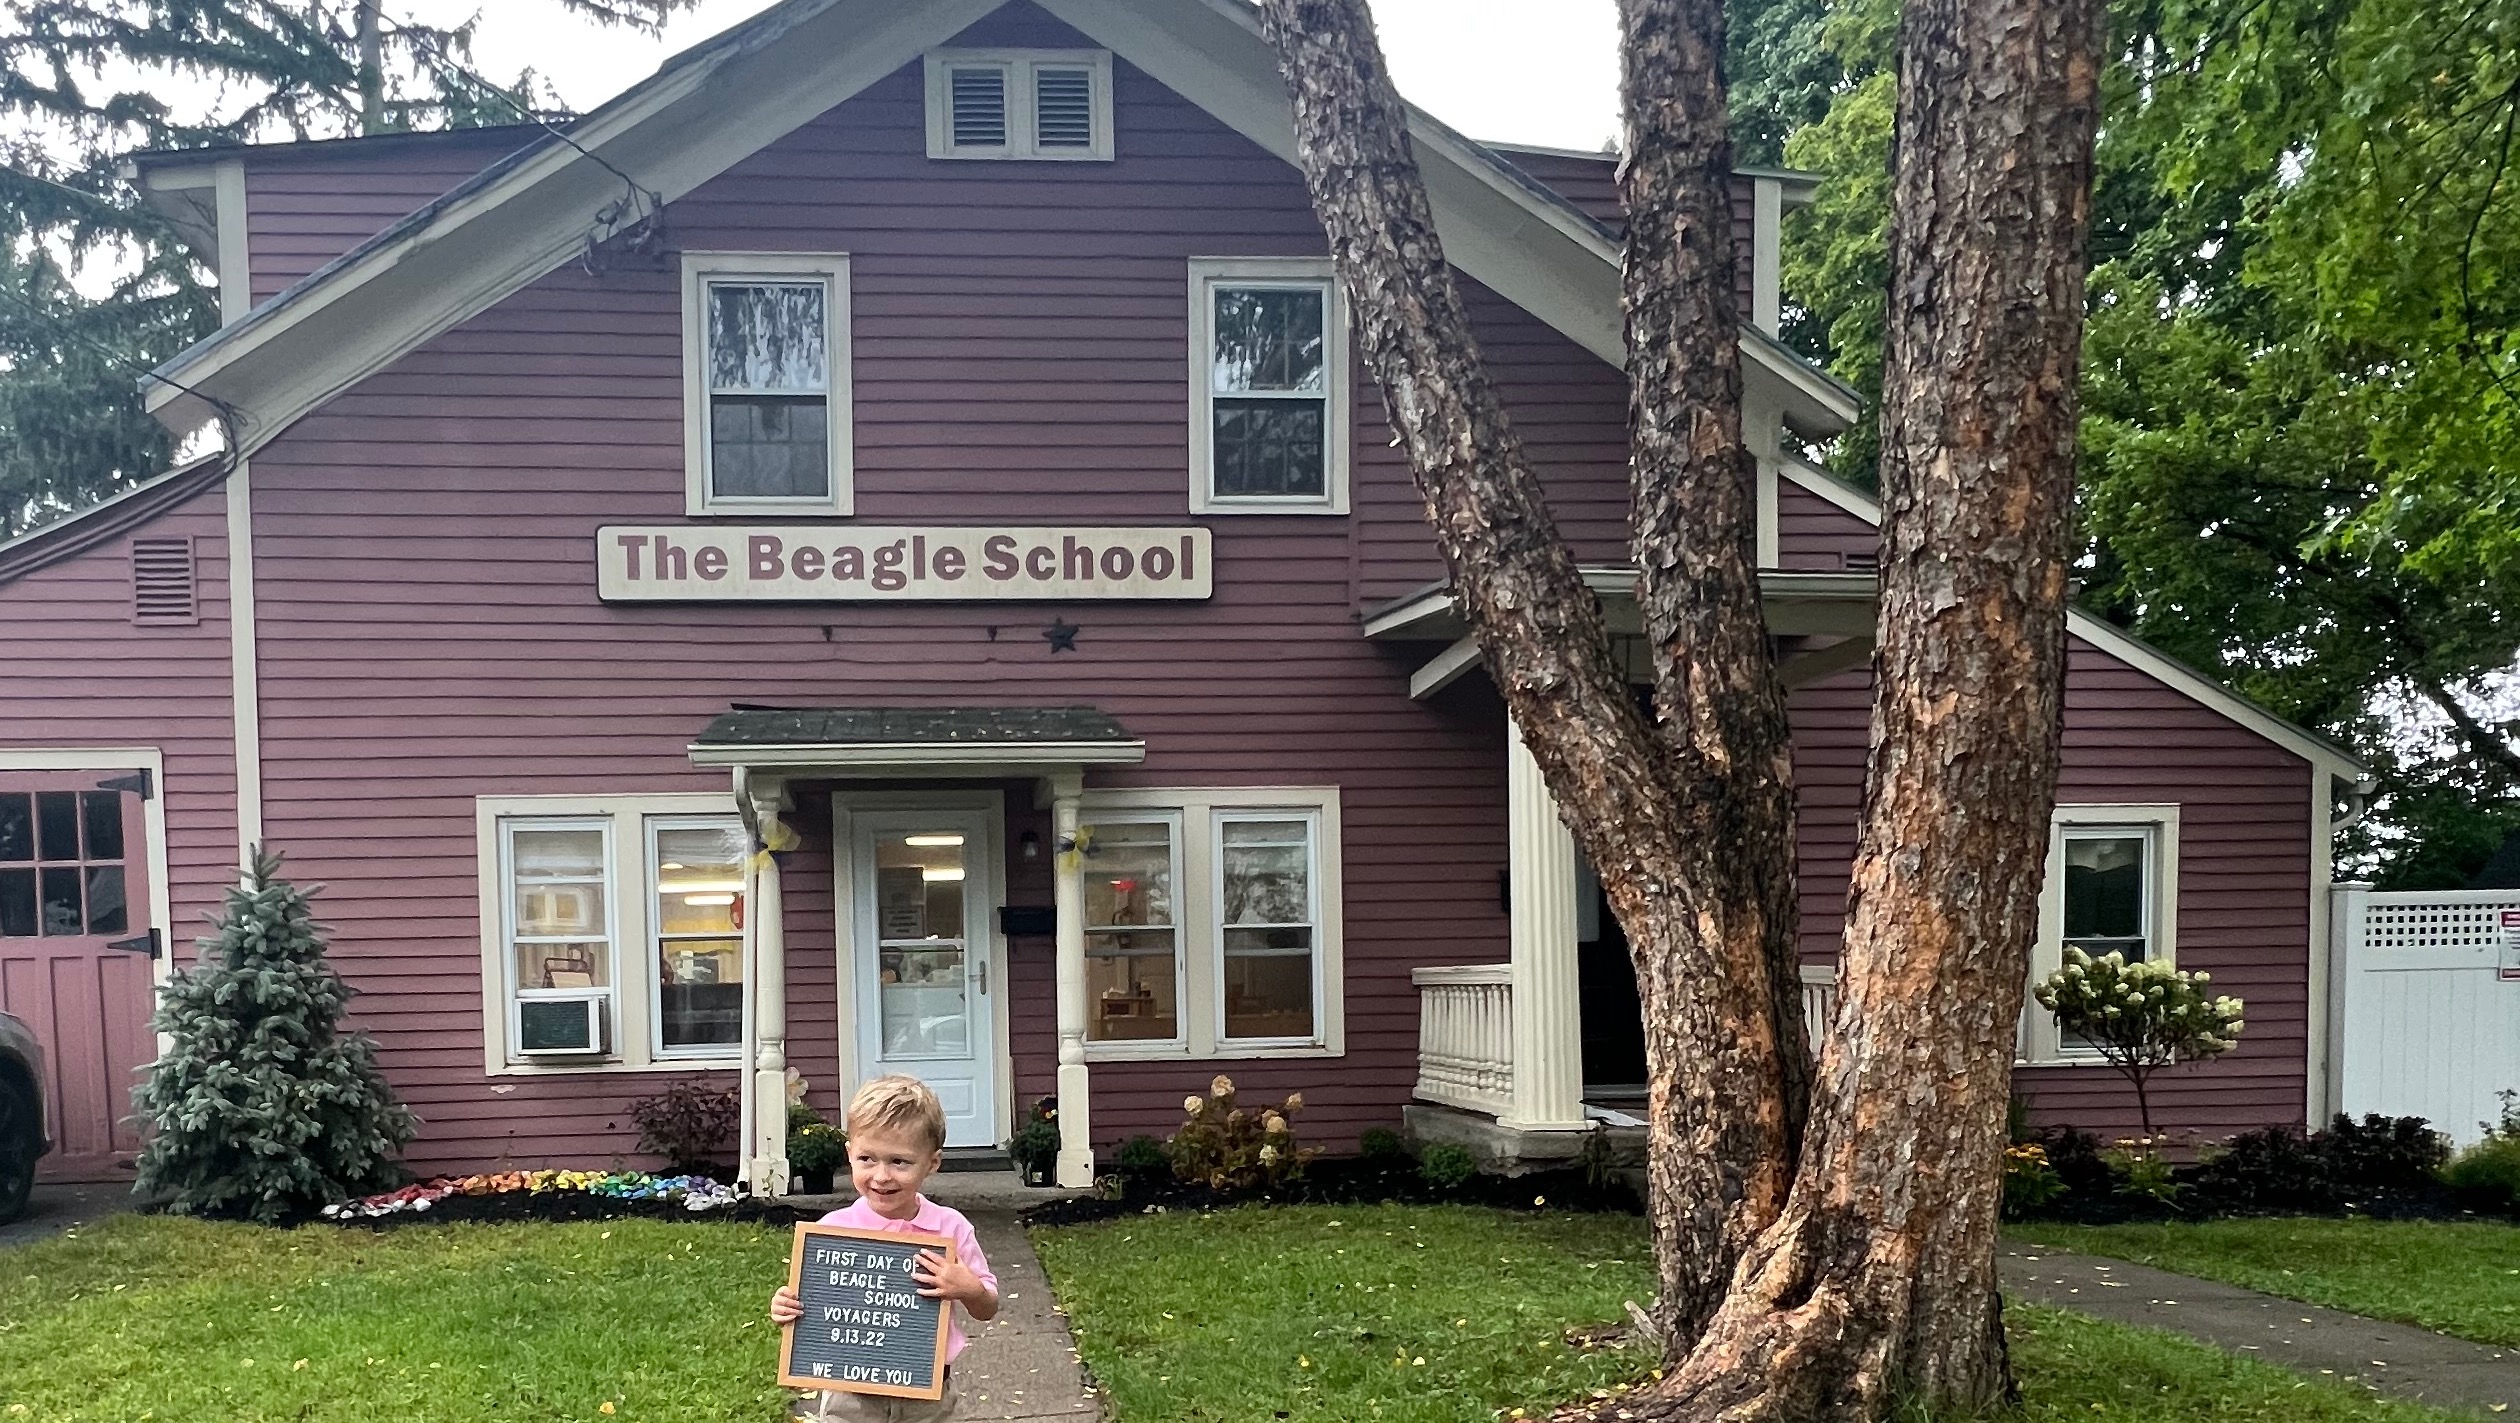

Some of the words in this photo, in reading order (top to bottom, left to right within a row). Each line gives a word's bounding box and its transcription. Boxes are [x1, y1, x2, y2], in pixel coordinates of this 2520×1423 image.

[617, 535, 729, 580] The
[748, 535, 966, 590] Beagle
[983, 535, 1194, 581] School
[815, 1249, 858, 1267] FIRST
[867, 1254, 894, 1271] DAY
[829, 1270, 887, 1290] BEAGLE
[864, 1290, 920, 1310] SCHOOL
[824, 1306, 901, 1328] VOYAGERS
[830, 1327, 885, 1347] 9.13.22
[812, 1362, 833, 1378] WE
[843, 1366, 880, 1383] LOVE
[885, 1369, 913, 1386] YOU
